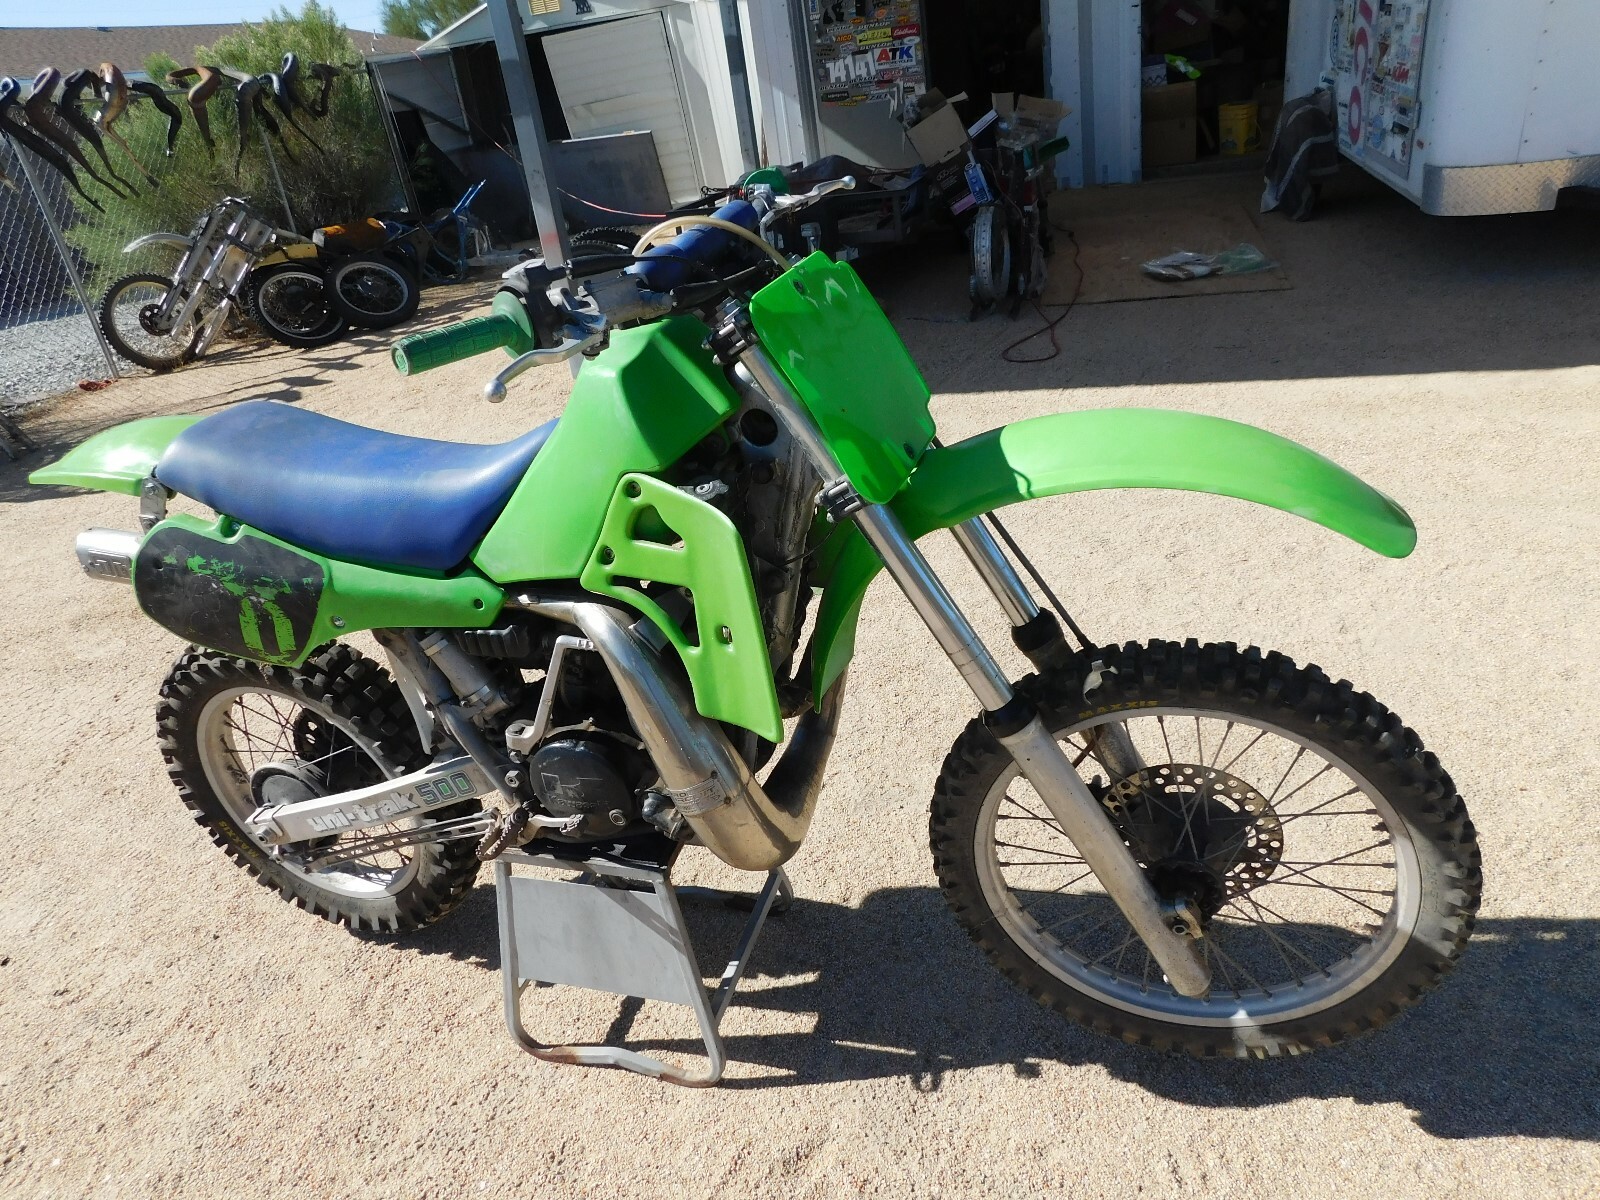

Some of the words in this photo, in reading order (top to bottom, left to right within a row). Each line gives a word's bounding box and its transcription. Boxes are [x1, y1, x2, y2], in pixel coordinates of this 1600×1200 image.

[876, 46, 914, 62] ATK
[1078, 700, 1159, 719] MAXXIS
[306, 791, 421, 833] uni-trak
[414, 770, 478, 807] 500
